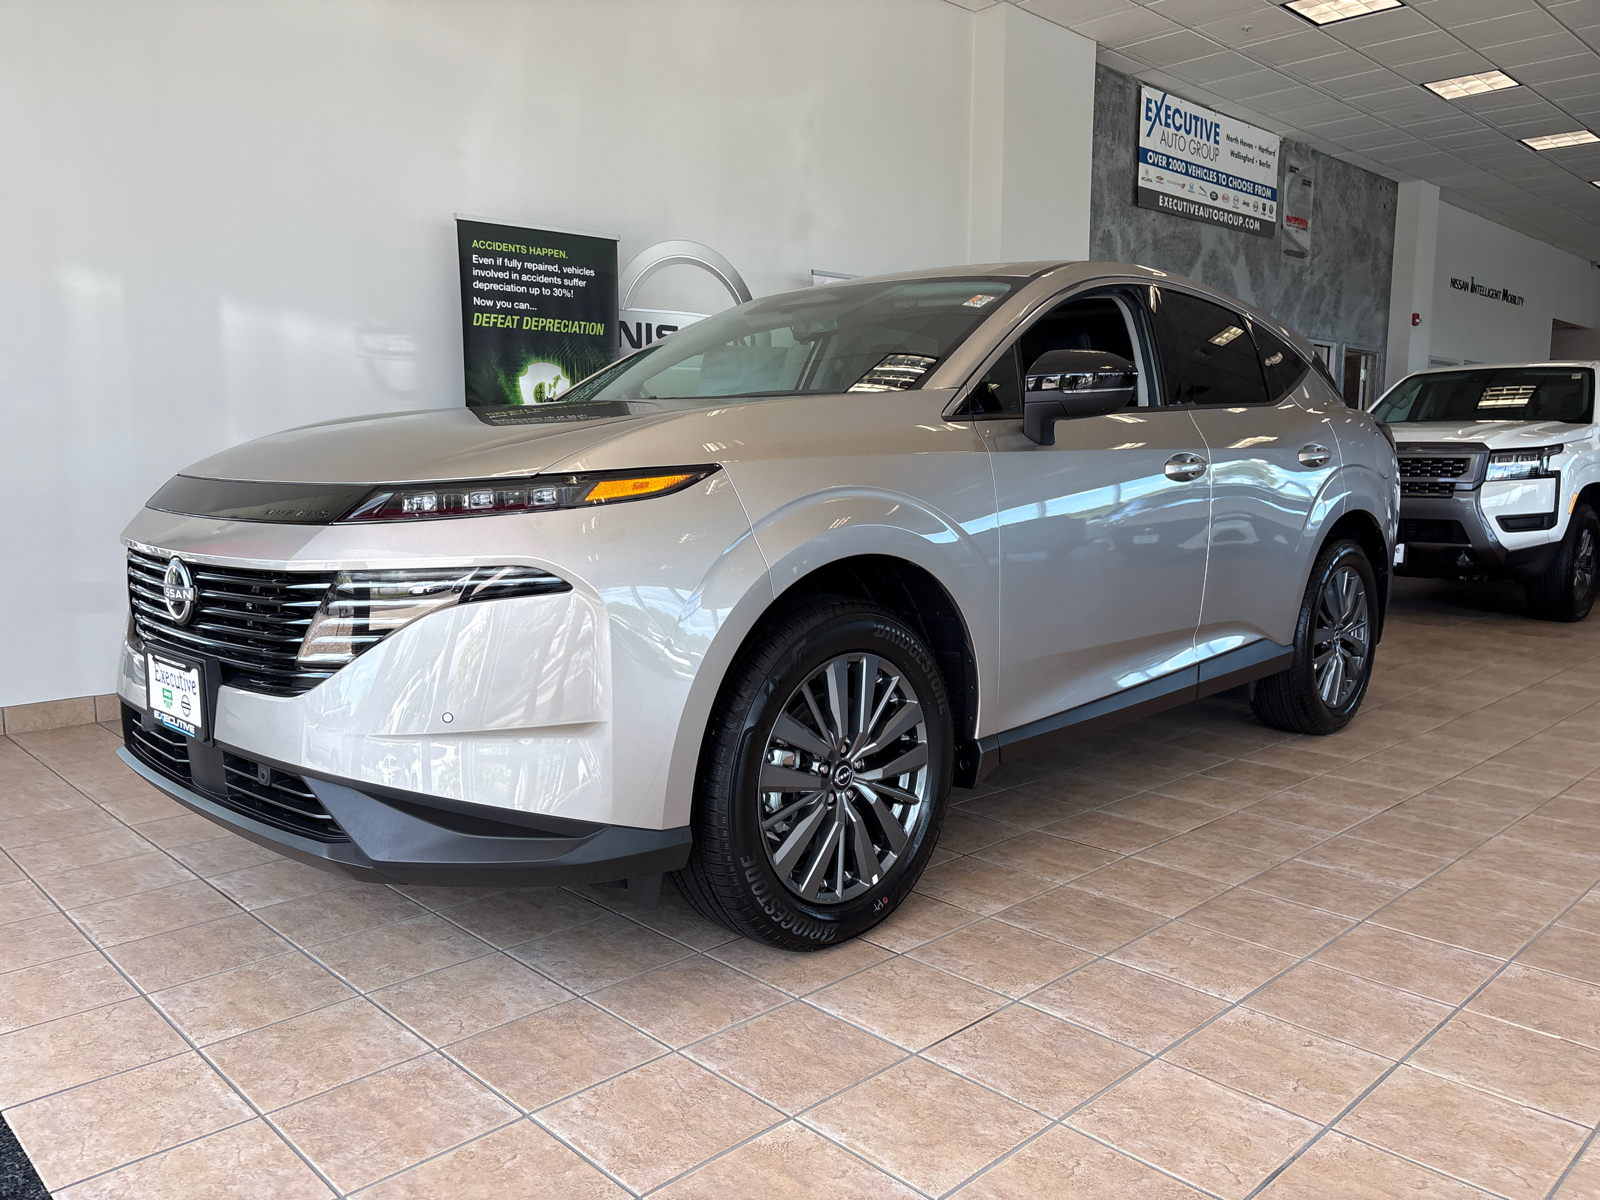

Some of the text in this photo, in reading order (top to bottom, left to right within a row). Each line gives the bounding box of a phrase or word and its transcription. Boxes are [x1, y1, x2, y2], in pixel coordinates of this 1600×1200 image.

[1145, 92, 1220, 145] EXECUTIVE
[1160, 130, 1220, 162] AUTO GROUP
[1226, 134, 1276, 157] North Haven Hartford
[1230, 150, 1271, 169] Wallingford Berlin
[1147, 152, 1271, 199] OVER 2000 VEHICLES TO CHOOSE FROM
[1158, 195, 1260, 230] EXECUTIVEAUTOGROUP.COM
[472, 239, 568, 259] ACCIDENTS HAPPEN.
[472, 254, 595, 277] Even if fully repaired, vehicles
[473, 267, 587, 287] involved in accidents suffer
[473, 280, 573, 298] depreciation up to 30%!
[1450, 277, 1524, 306] NISSAN INTELLIGENT MOBILITY
[473, 296, 537, 310] Now you can...
[473, 312, 605, 336] DEFEAT DEPRECIATION
[619, 320, 679, 350] NIS
[165, 587, 192, 600] SSAN
[154, 663, 197, 695] Executive
[873, 622, 948, 716] BRIDGESTONE
[154, 711, 195, 738] EXECUTIVE
[741, 854, 840, 942] BRIDGESTONE
